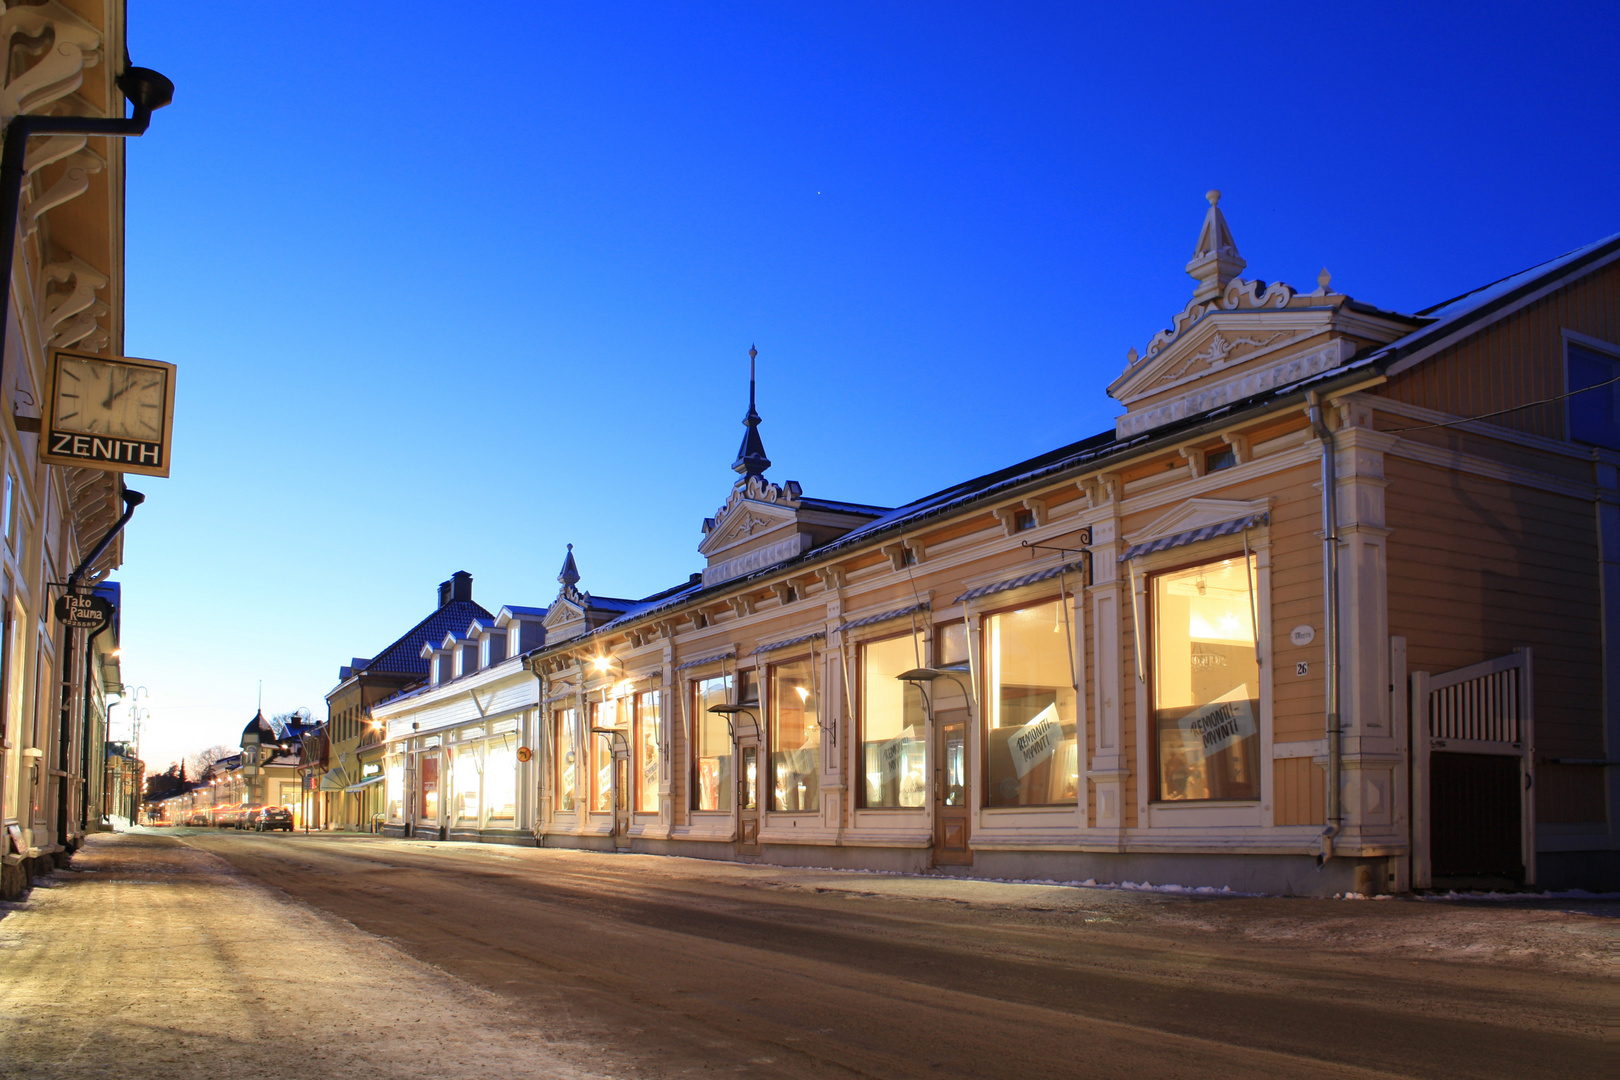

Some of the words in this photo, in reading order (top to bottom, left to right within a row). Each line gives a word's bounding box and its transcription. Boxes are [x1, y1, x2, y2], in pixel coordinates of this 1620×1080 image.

[52, 432, 159, 465] ZENITH
[64, 594, 92, 609] Tako
[70, 606, 103, 621] Rauma
[1297, 663, 1307, 675] 26
[1202, 718, 1239, 749] MYYNTI
[1022, 733, 1051, 763] MYYNTI
